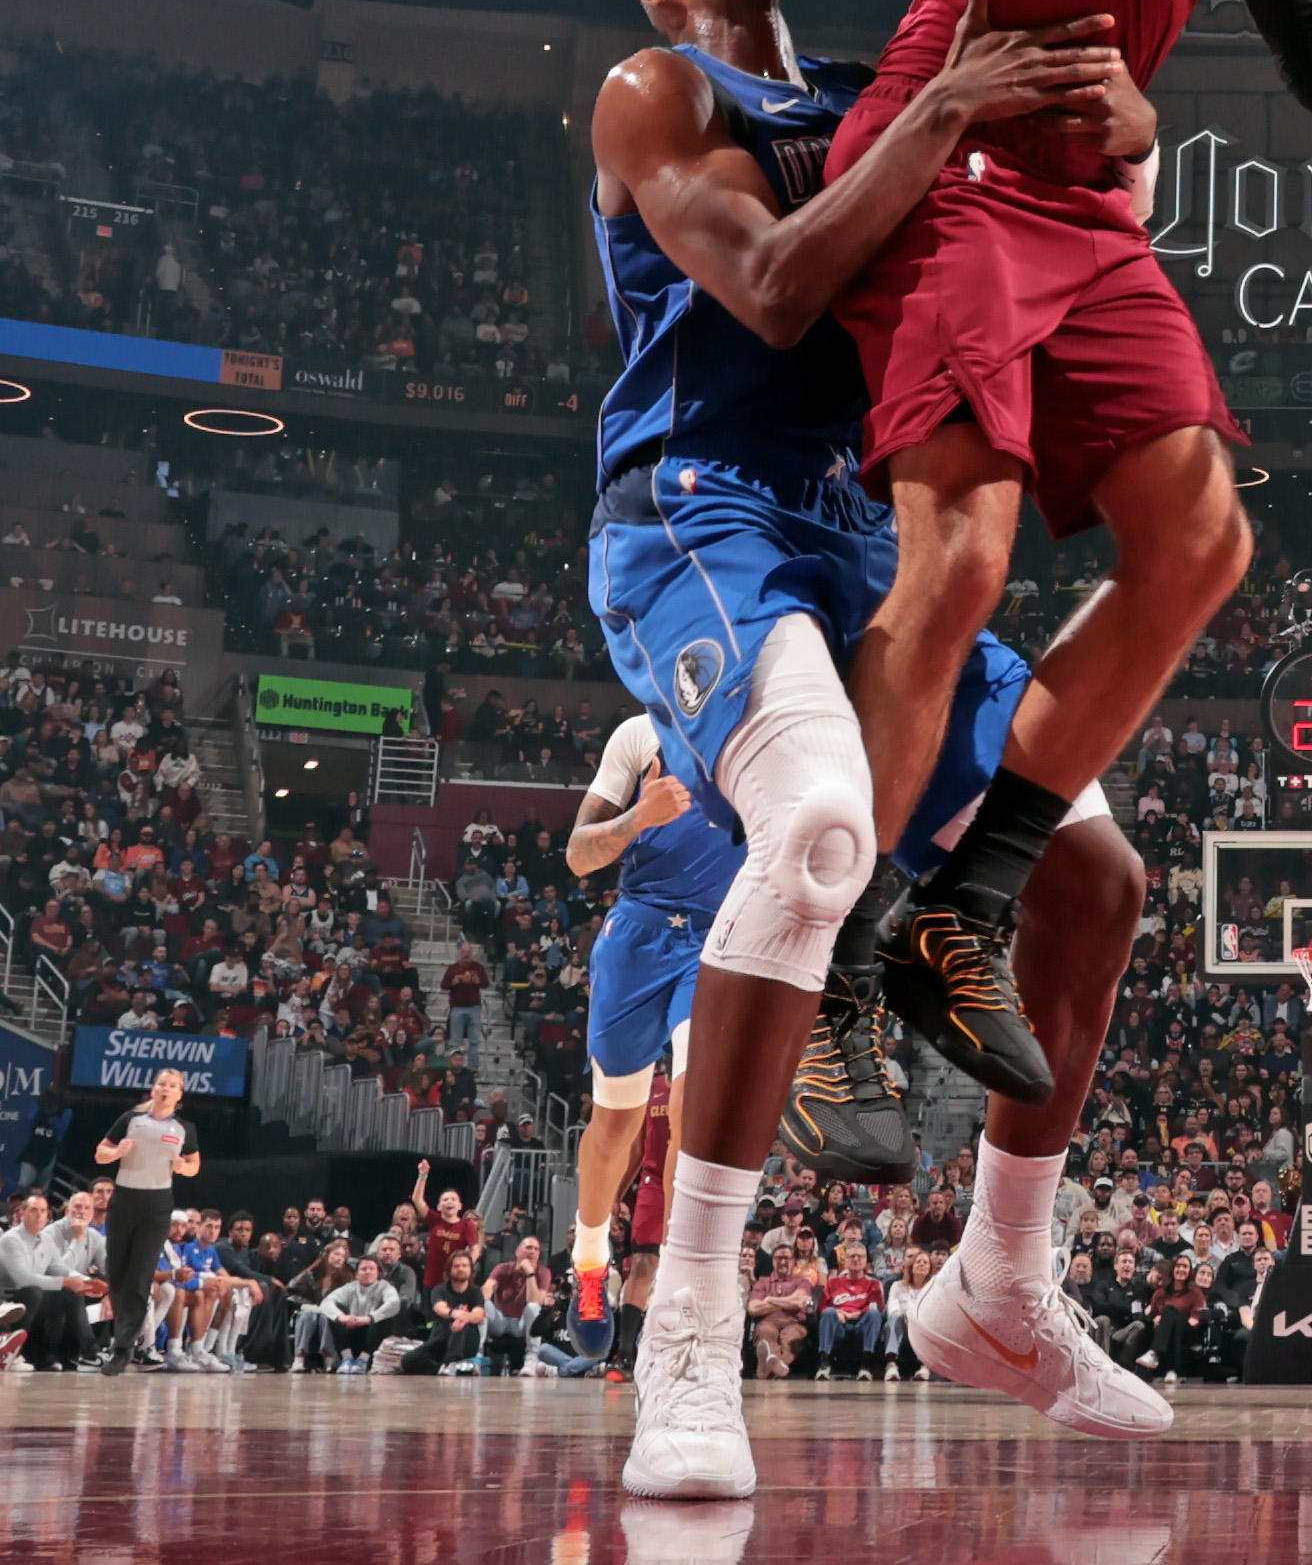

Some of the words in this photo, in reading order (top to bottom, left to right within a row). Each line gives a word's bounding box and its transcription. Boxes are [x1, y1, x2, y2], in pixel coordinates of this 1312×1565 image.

[72, 205, 98, 220] 215
[113, 211, 139, 225] 216
[225, 352, 280, 370] TONIGHT'S
[235, 371, 264, 386] TOTAL
[295, 369, 363, 391] oswald
[505, 394, 528, 408] DIFF
[58, 617, 188, 646] LITEHOUSE
[282, 693, 367, 717] Huntington
[104, 1030, 215, 1064] SHERWIN
